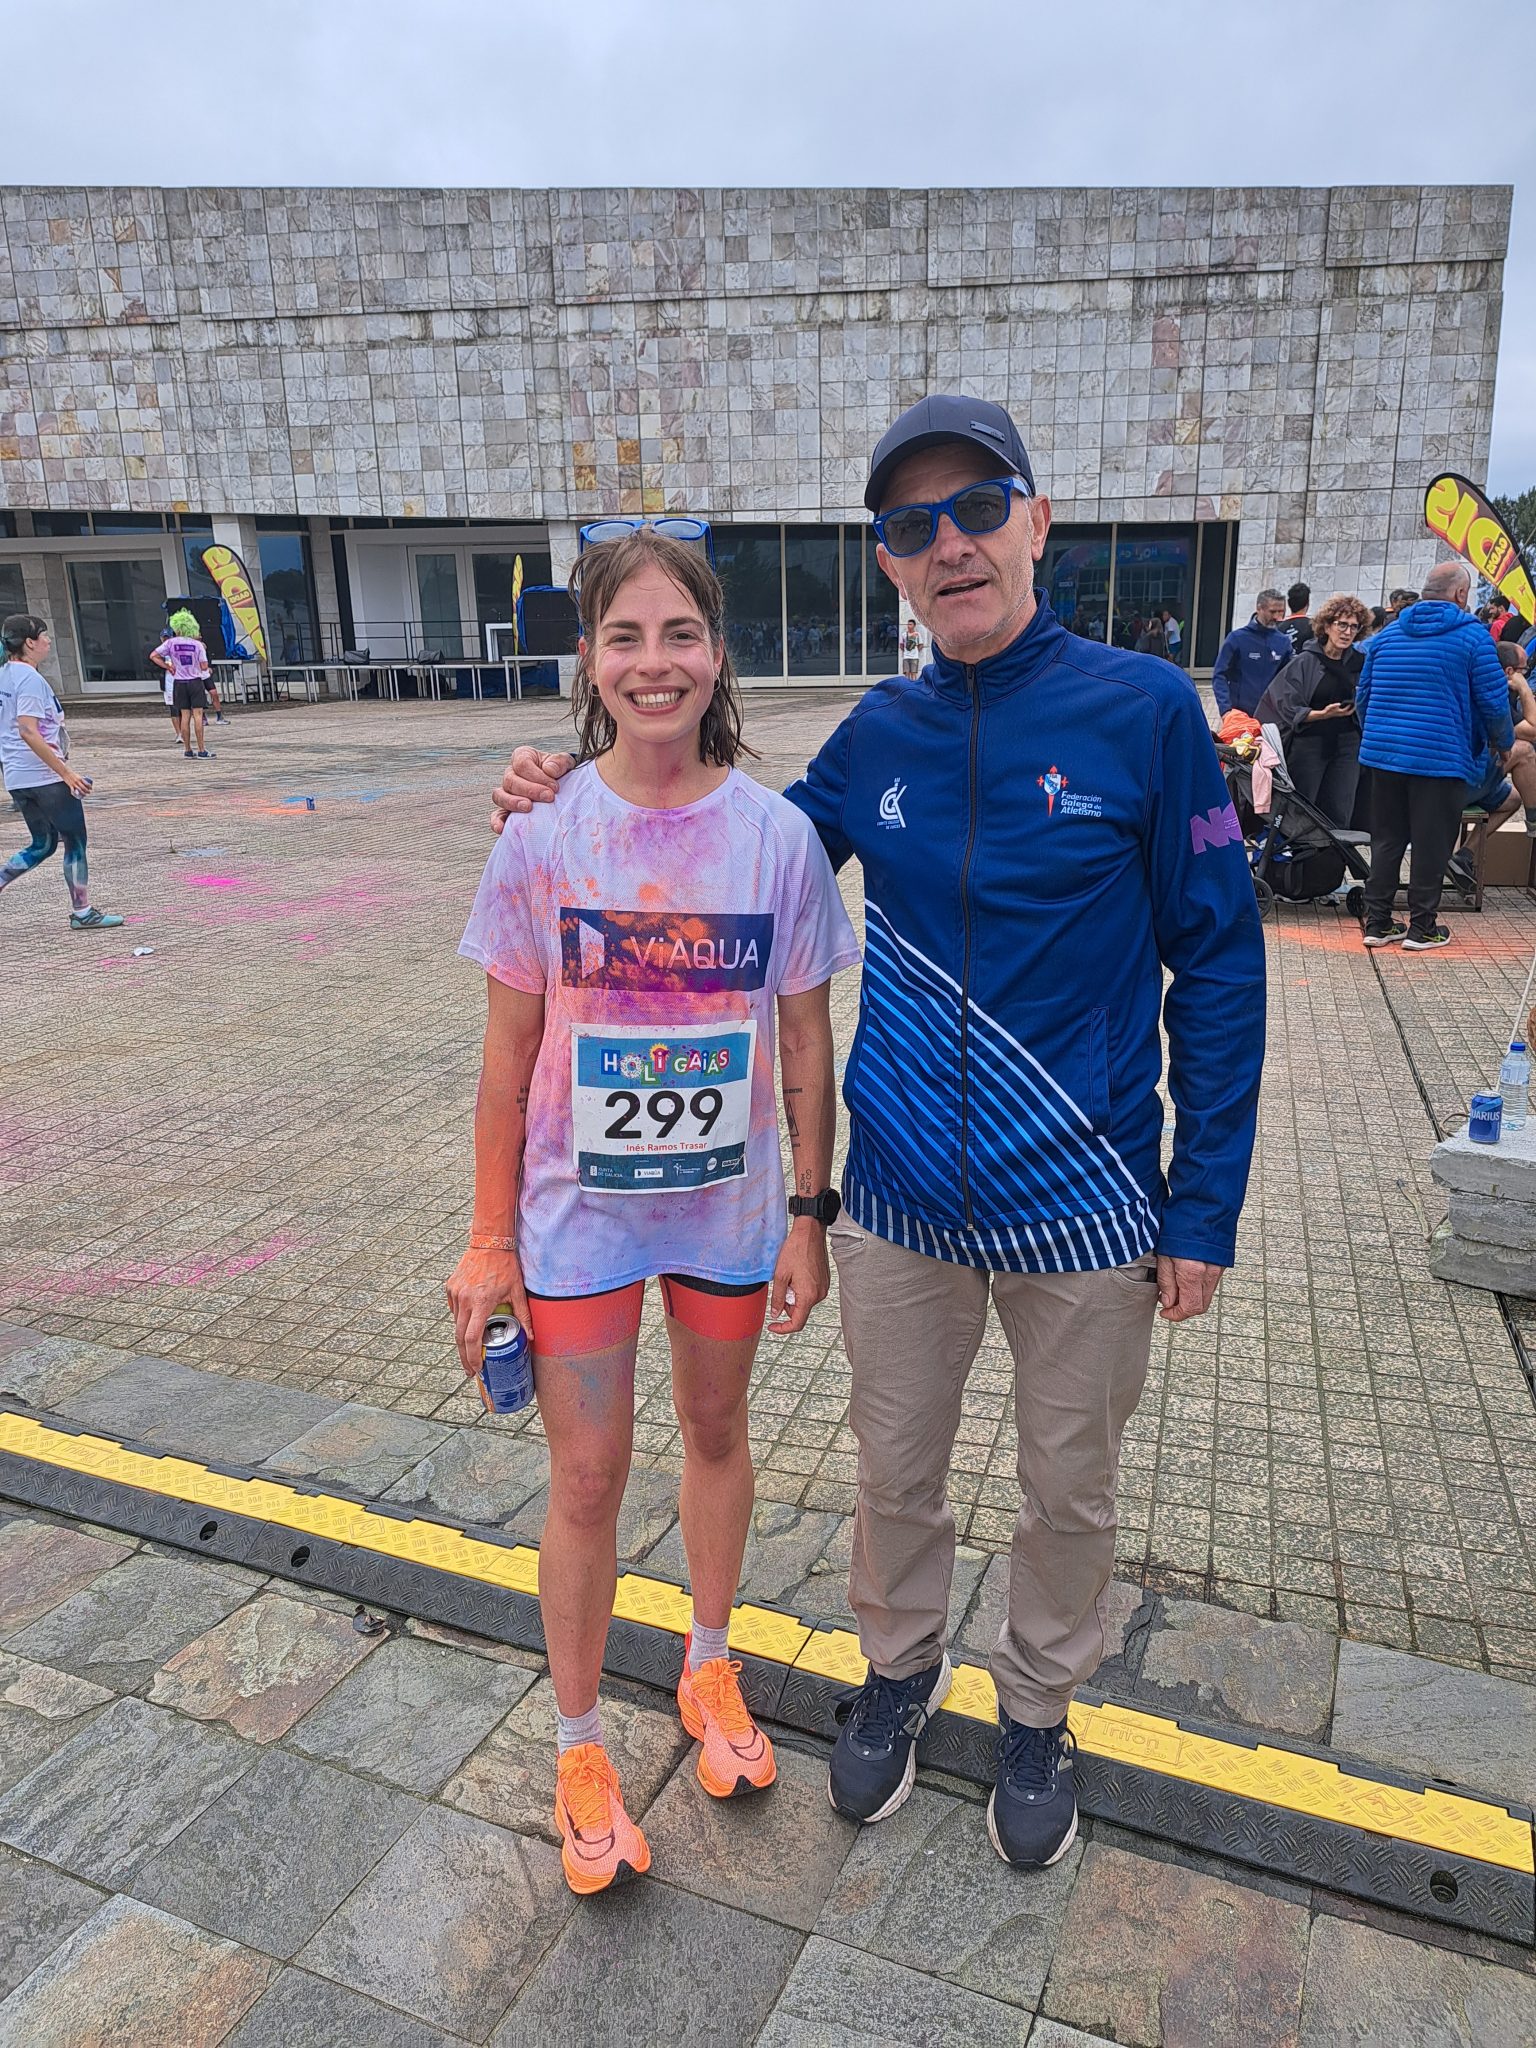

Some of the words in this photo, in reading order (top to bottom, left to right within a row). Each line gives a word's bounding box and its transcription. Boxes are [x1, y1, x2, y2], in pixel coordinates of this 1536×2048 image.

[1061, 790, 1102, 803] Federación
[1061, 799, 1093, 810] Galega
[1060, 806, 1102, 818] Atletismo
[605, 1088, 723, 1139] 299
[1471, 1109, 1501, 1121] UARIUS
[626, 1143, 645, 1152] Inés
[648, 1143, 678, 1152] Ramos
[680, 1141, 707, 1151] Trasar
[504, 1557, 537, 1575] Trito
[1101, 1720, 1160, 1750] Triton
